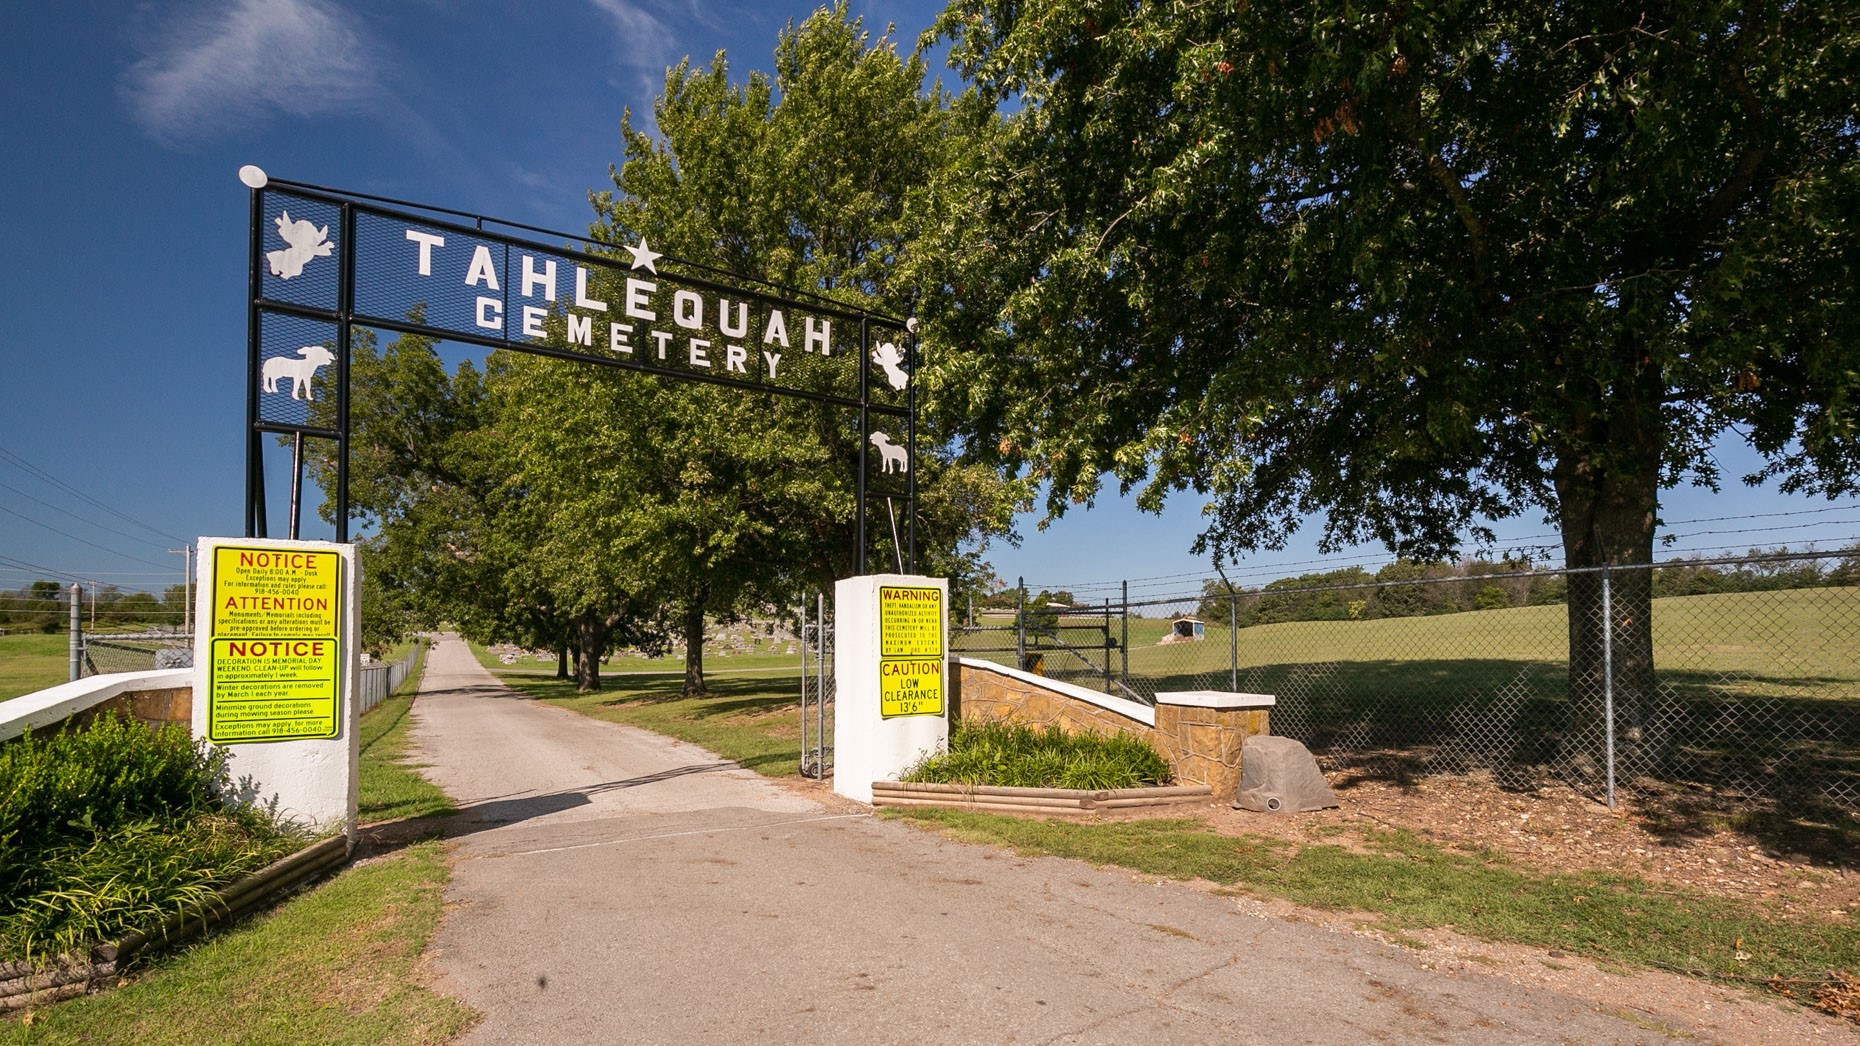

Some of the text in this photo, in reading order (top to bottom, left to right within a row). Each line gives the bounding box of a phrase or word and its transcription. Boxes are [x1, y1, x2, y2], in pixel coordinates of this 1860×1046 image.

[405, 230, 830, 356] TAHLEQUAH
[476, 296, 782, 379] CEMETERY
[240, 552, 317, 569] NOTICE
[236, 567, 250, 575] Open
[253, 568, 268, 576] Daily
[883, 589, 939, 602] WARNING
[225, 596, 327, 611] ATTENTION
[229, 642, 324, 657] NOTICE
[882, 662, 940, 676] CAUTION
[225, 672, 273, 680] approximately
[900, 678, 919, 689] LOW
[884, 689, 938, 702] CLEARANCE
[248, 703, 272, 711] ground
[900, 702, 924, 713] 13'6"
[240, 710, 268, 718] mowing
[215, 722, 254, 731] Exceptions
[256, 722, 271, 730] may
[215, 729, 257, 737] information
[272, 726, 322, 734] 918-456-0040
